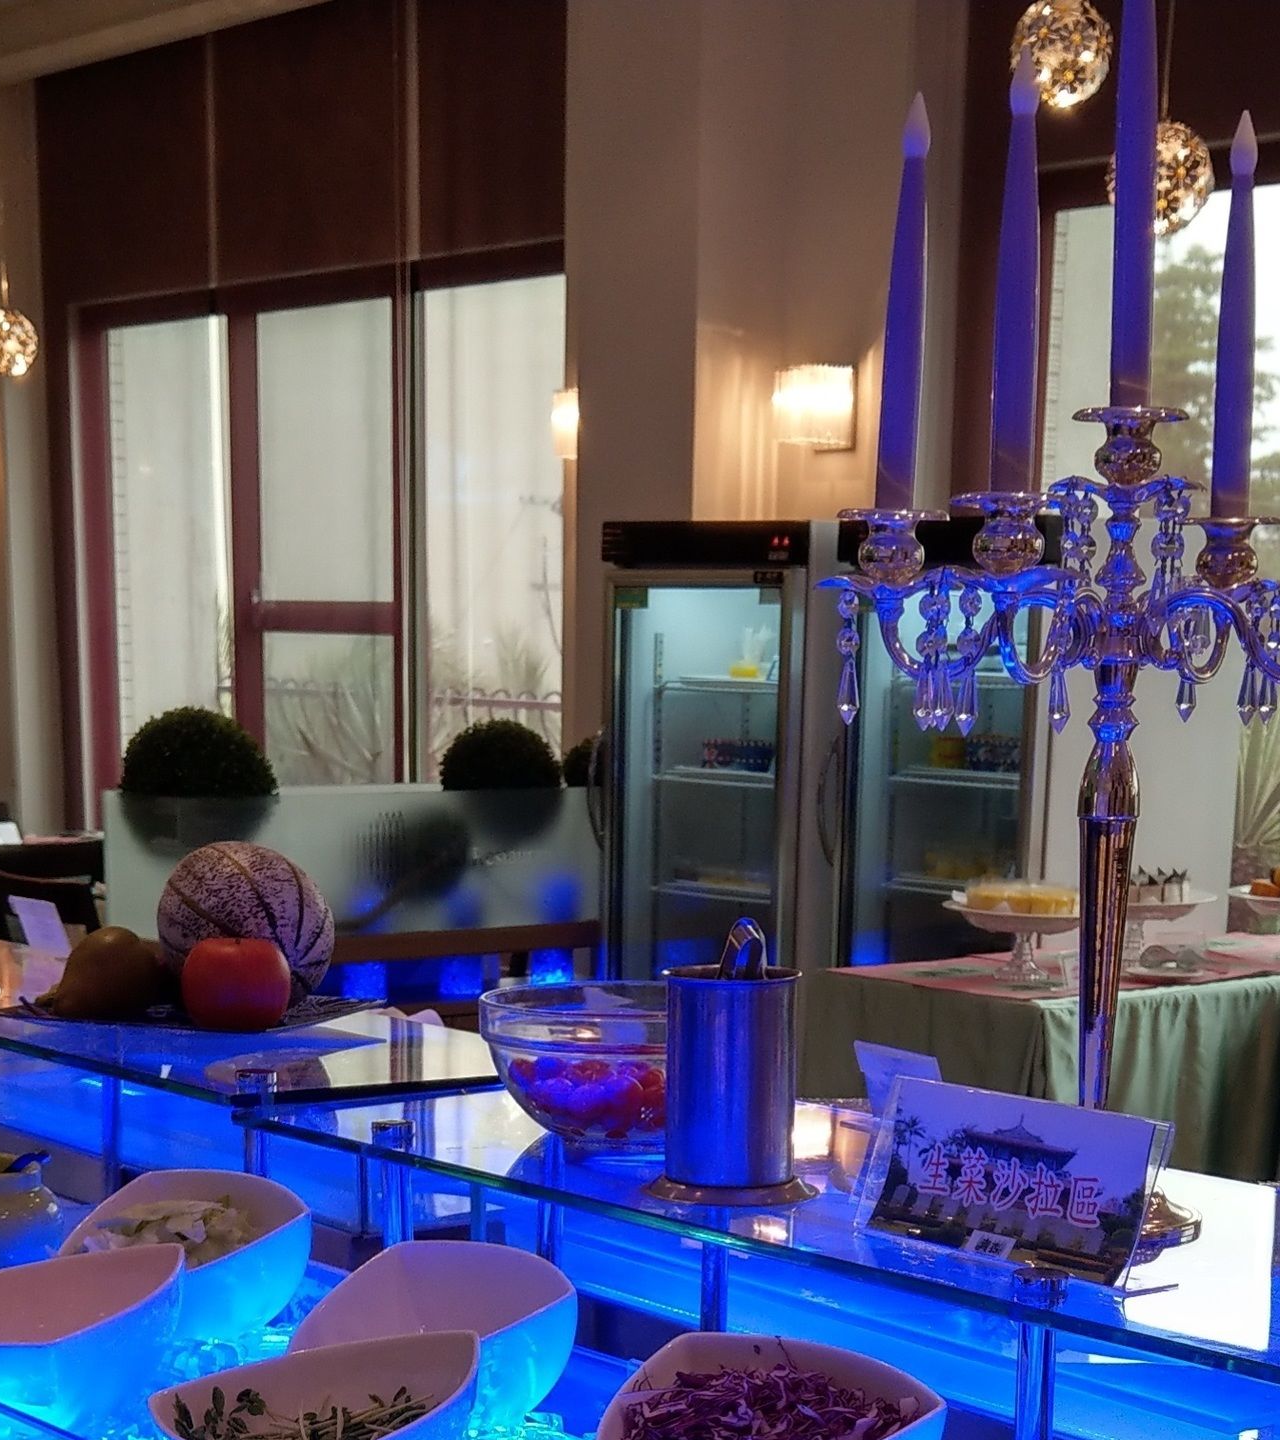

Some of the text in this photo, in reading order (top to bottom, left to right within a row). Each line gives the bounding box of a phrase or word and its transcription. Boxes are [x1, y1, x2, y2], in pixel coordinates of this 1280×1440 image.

[918, 1143, 1103, 1229] 生菜沙拉區
